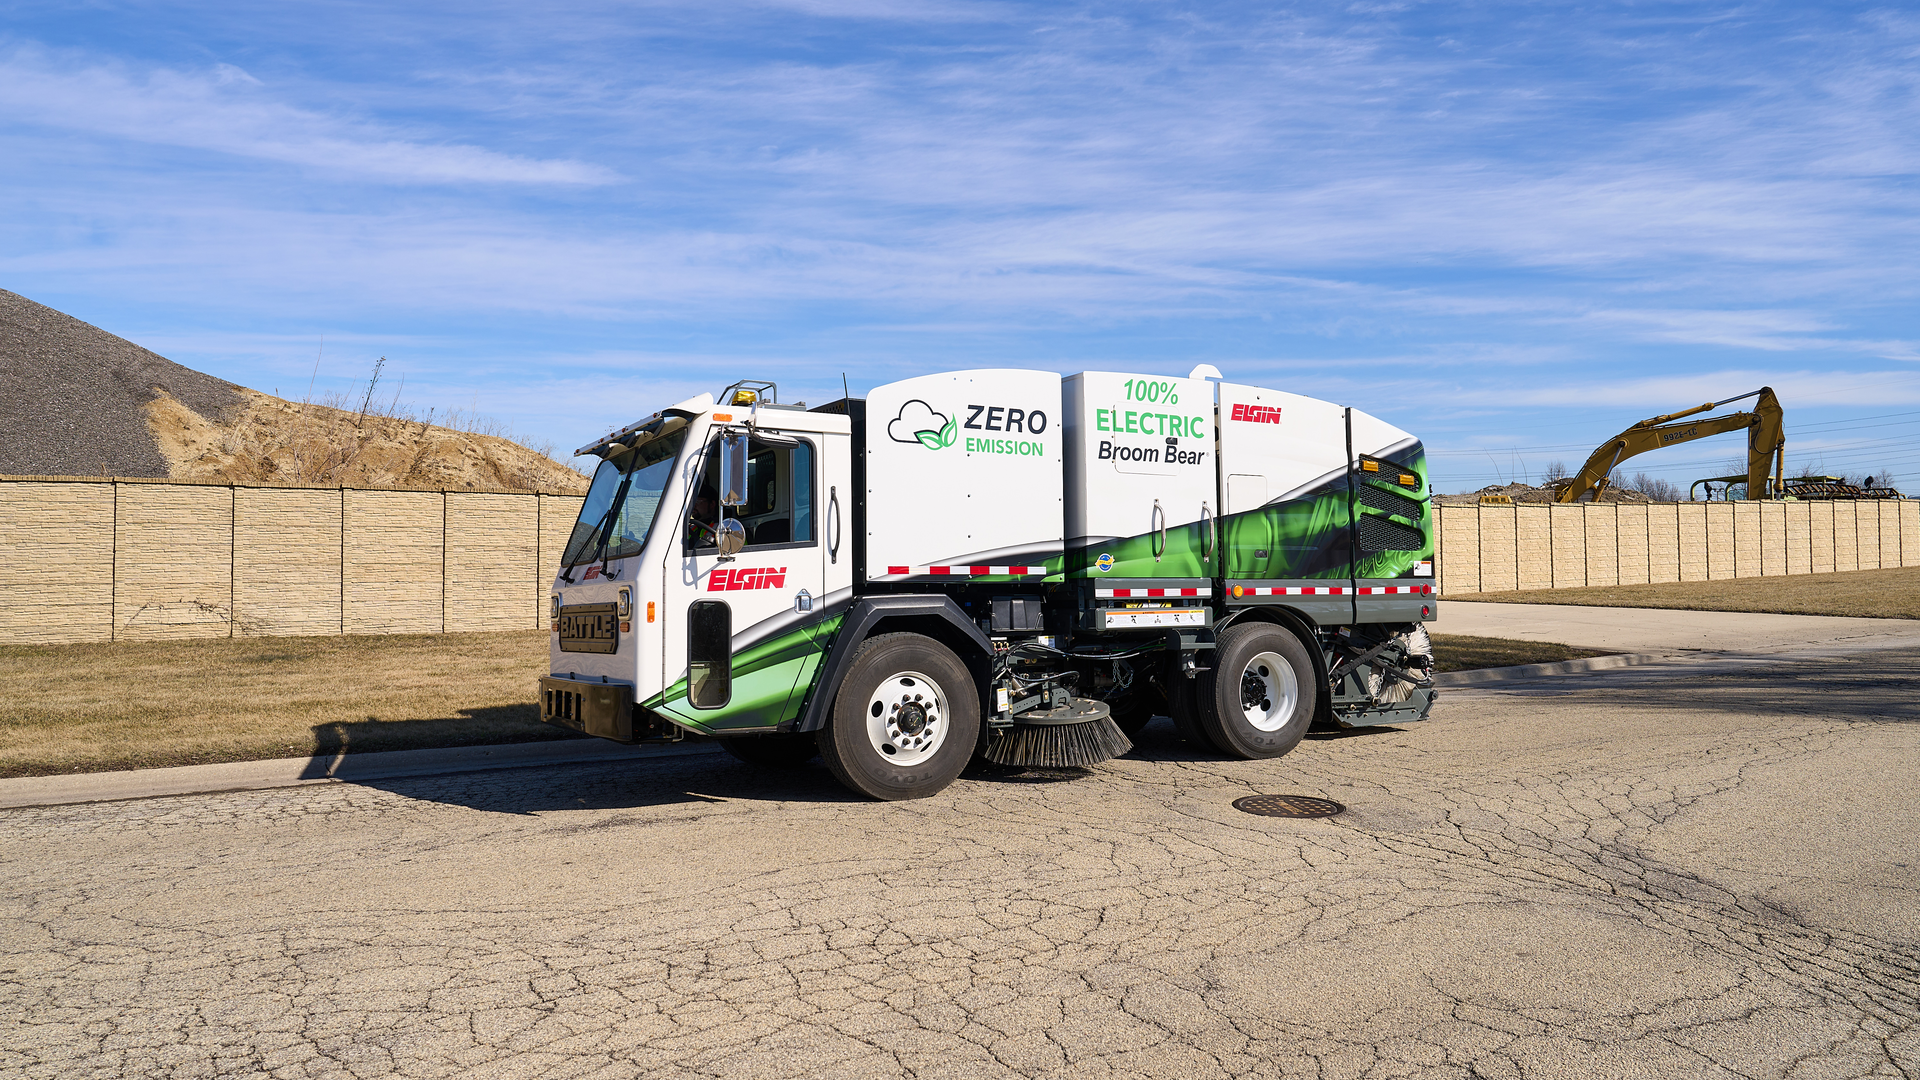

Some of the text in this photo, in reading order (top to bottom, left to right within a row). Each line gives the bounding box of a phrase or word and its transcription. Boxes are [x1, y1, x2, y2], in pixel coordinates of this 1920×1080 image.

[1124, 379, 1178, 405] 100%
[964, 404, 1047, 434] ZERO
[1096, 408, 1205, 439] ELECTRIC
[1231, 403, 1282, 425] ELGIN
[966, 437, 1043, 456] EMISSION
[1098, 440, 1205, 465] Broom Bear
[707, 566, 788, 592] ELGIN
[561, 614, 615, 639] BATTLE
[873, 767, 933, 784] TOYO
